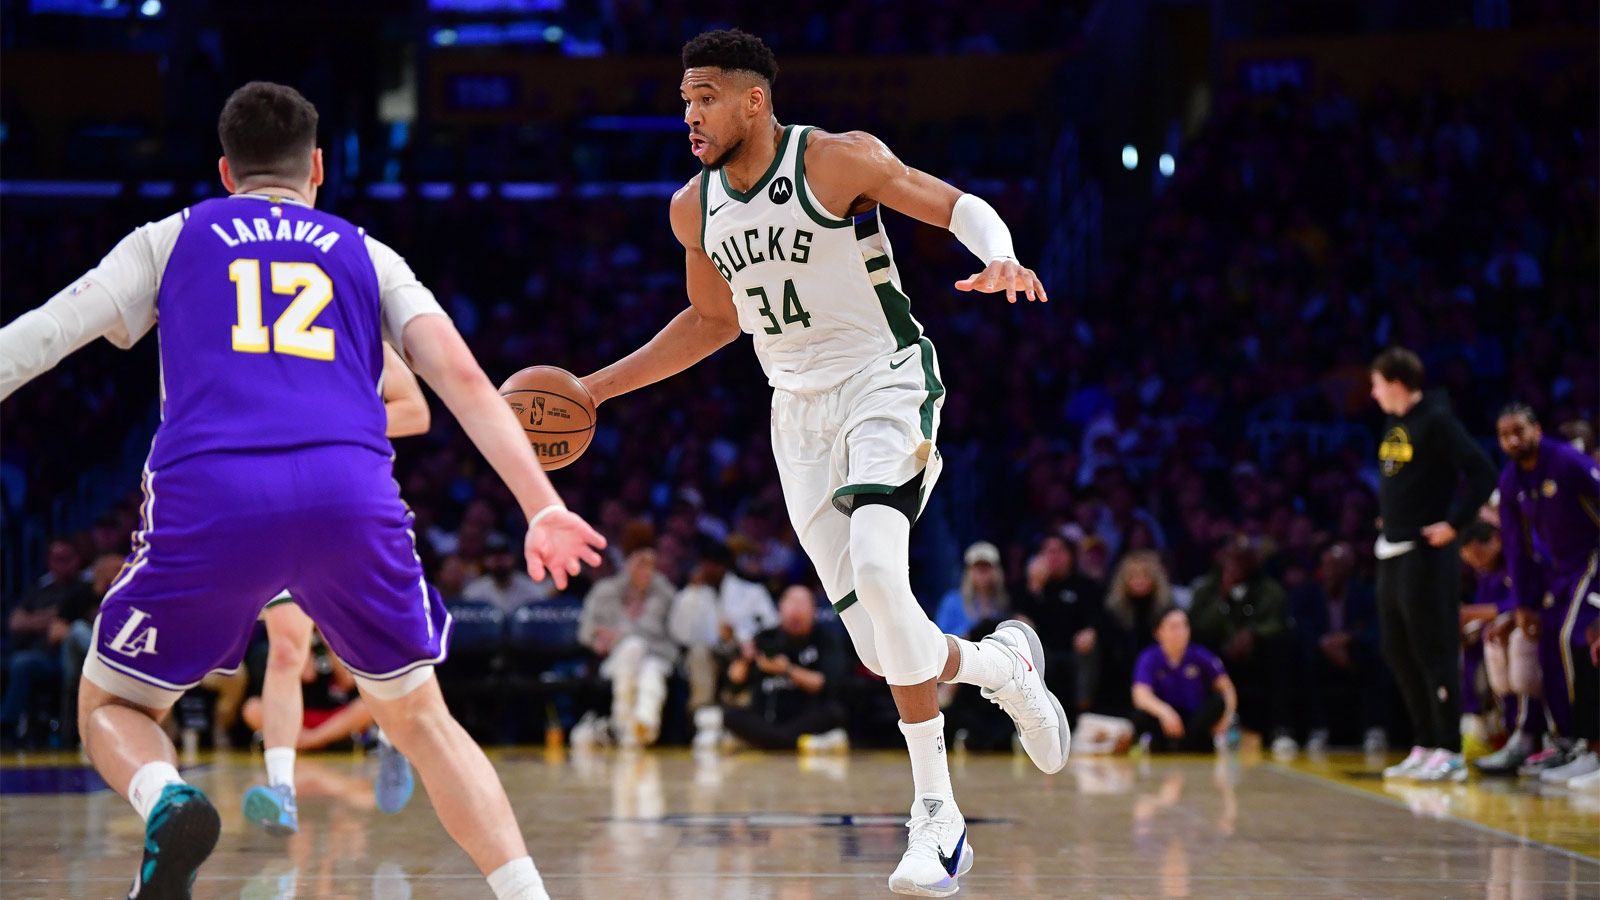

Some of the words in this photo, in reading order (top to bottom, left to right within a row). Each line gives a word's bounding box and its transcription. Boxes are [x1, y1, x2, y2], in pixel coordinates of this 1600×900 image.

[210, 218, 340, 253] LARAVIA
[711, 226, 814, 283] BUCKS
[228, 258, 335, 361] 12
[745, 279, 811, 334] 34
[104, 606, 158, 658] LA
